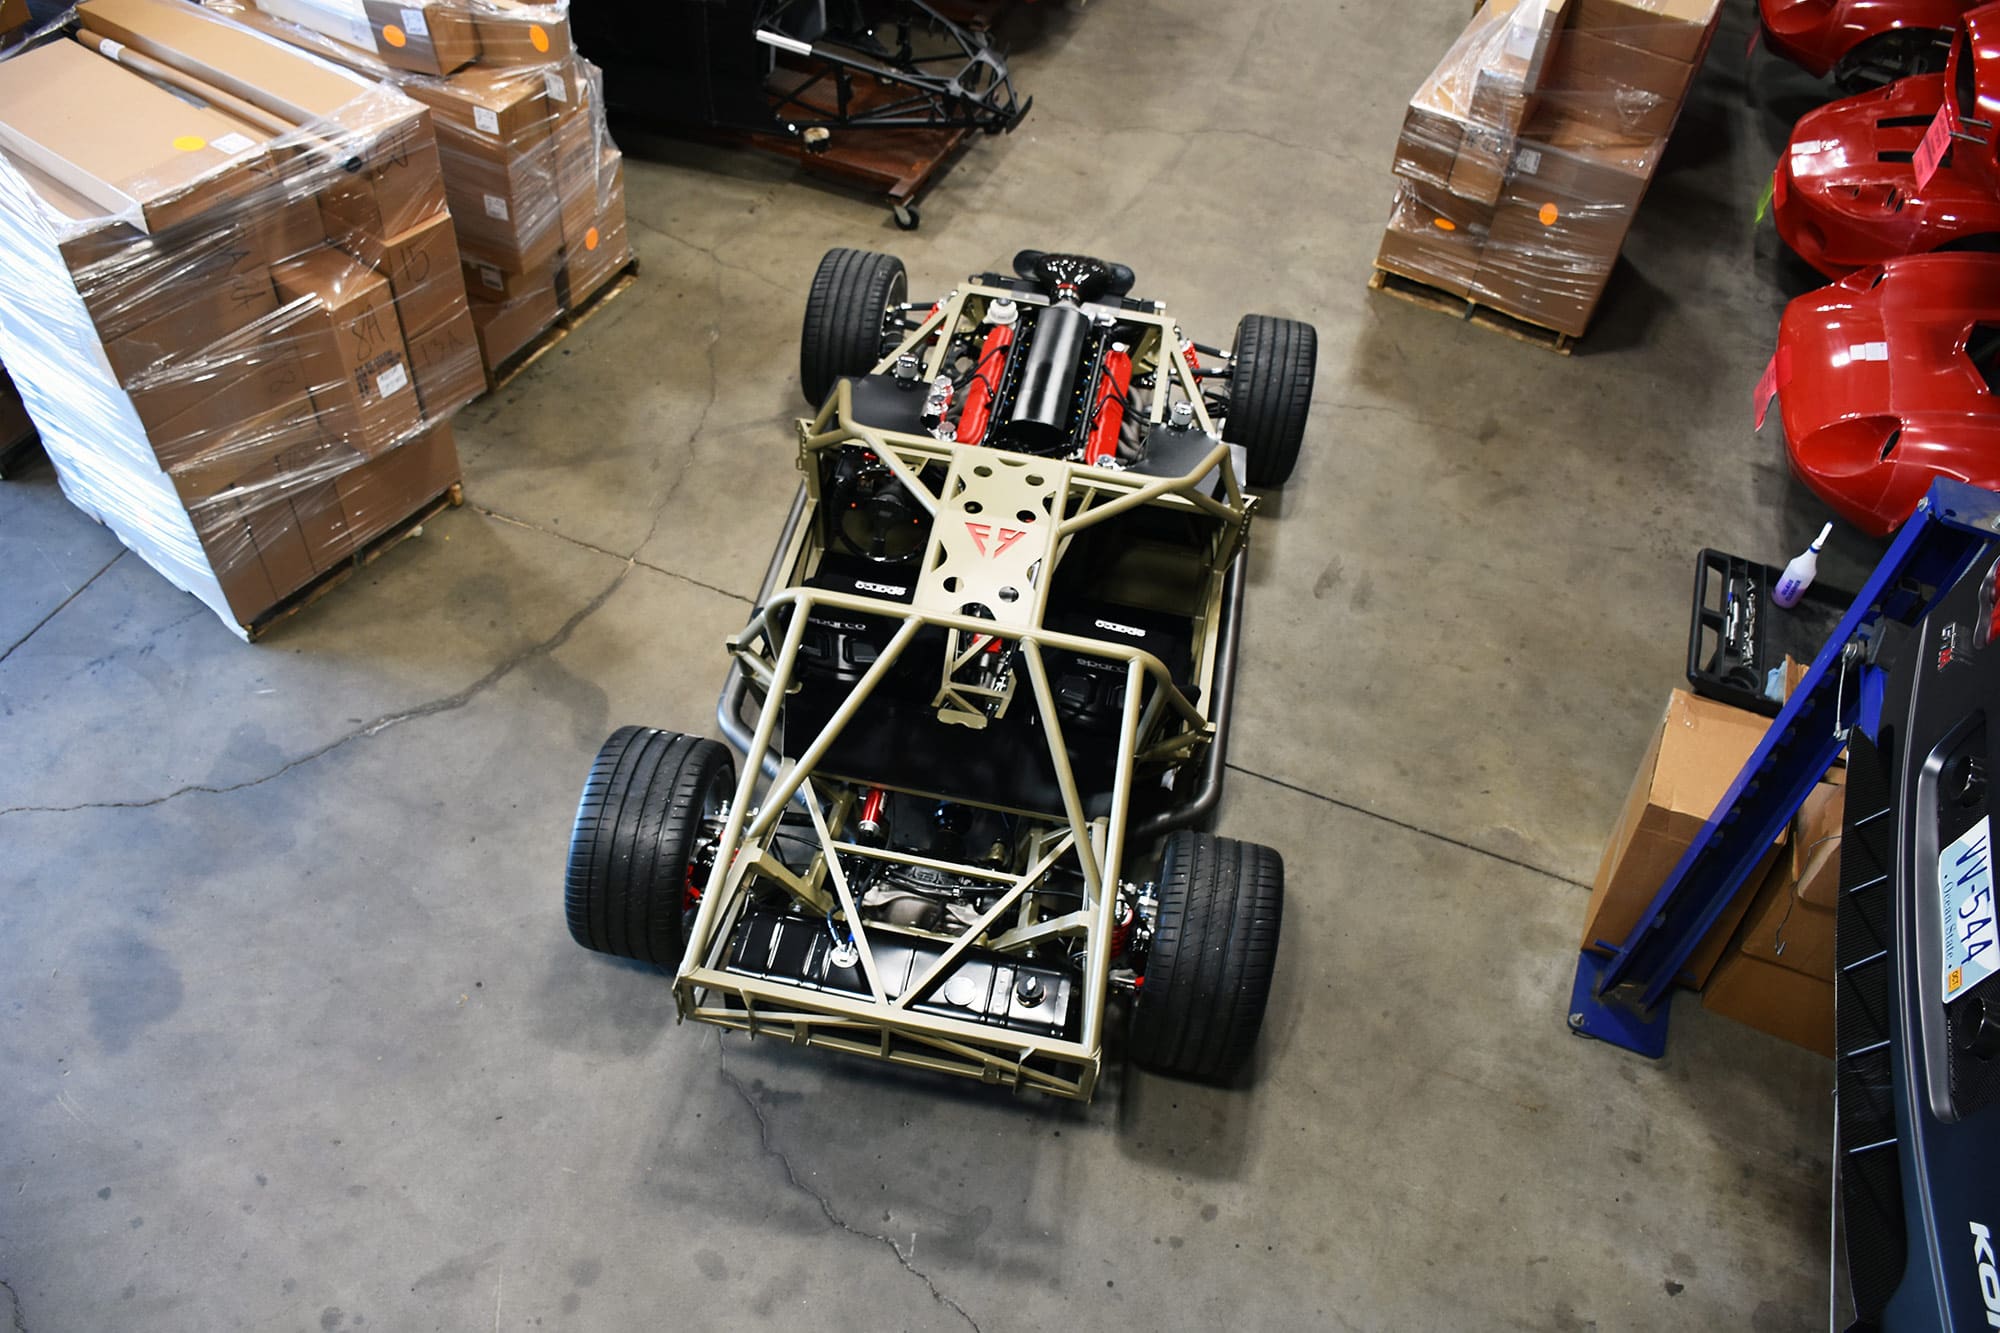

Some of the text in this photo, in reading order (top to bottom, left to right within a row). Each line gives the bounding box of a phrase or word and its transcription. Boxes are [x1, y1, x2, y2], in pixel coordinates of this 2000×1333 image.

[855, 580, 907, 596] sparco
[1095, 619, 1146, 637] sparco
[1076, 658, 1127, 673] sparc
[1956, 835, 1993, 965] VV-544
[1943, 881, 1957, 960] Ocean State
